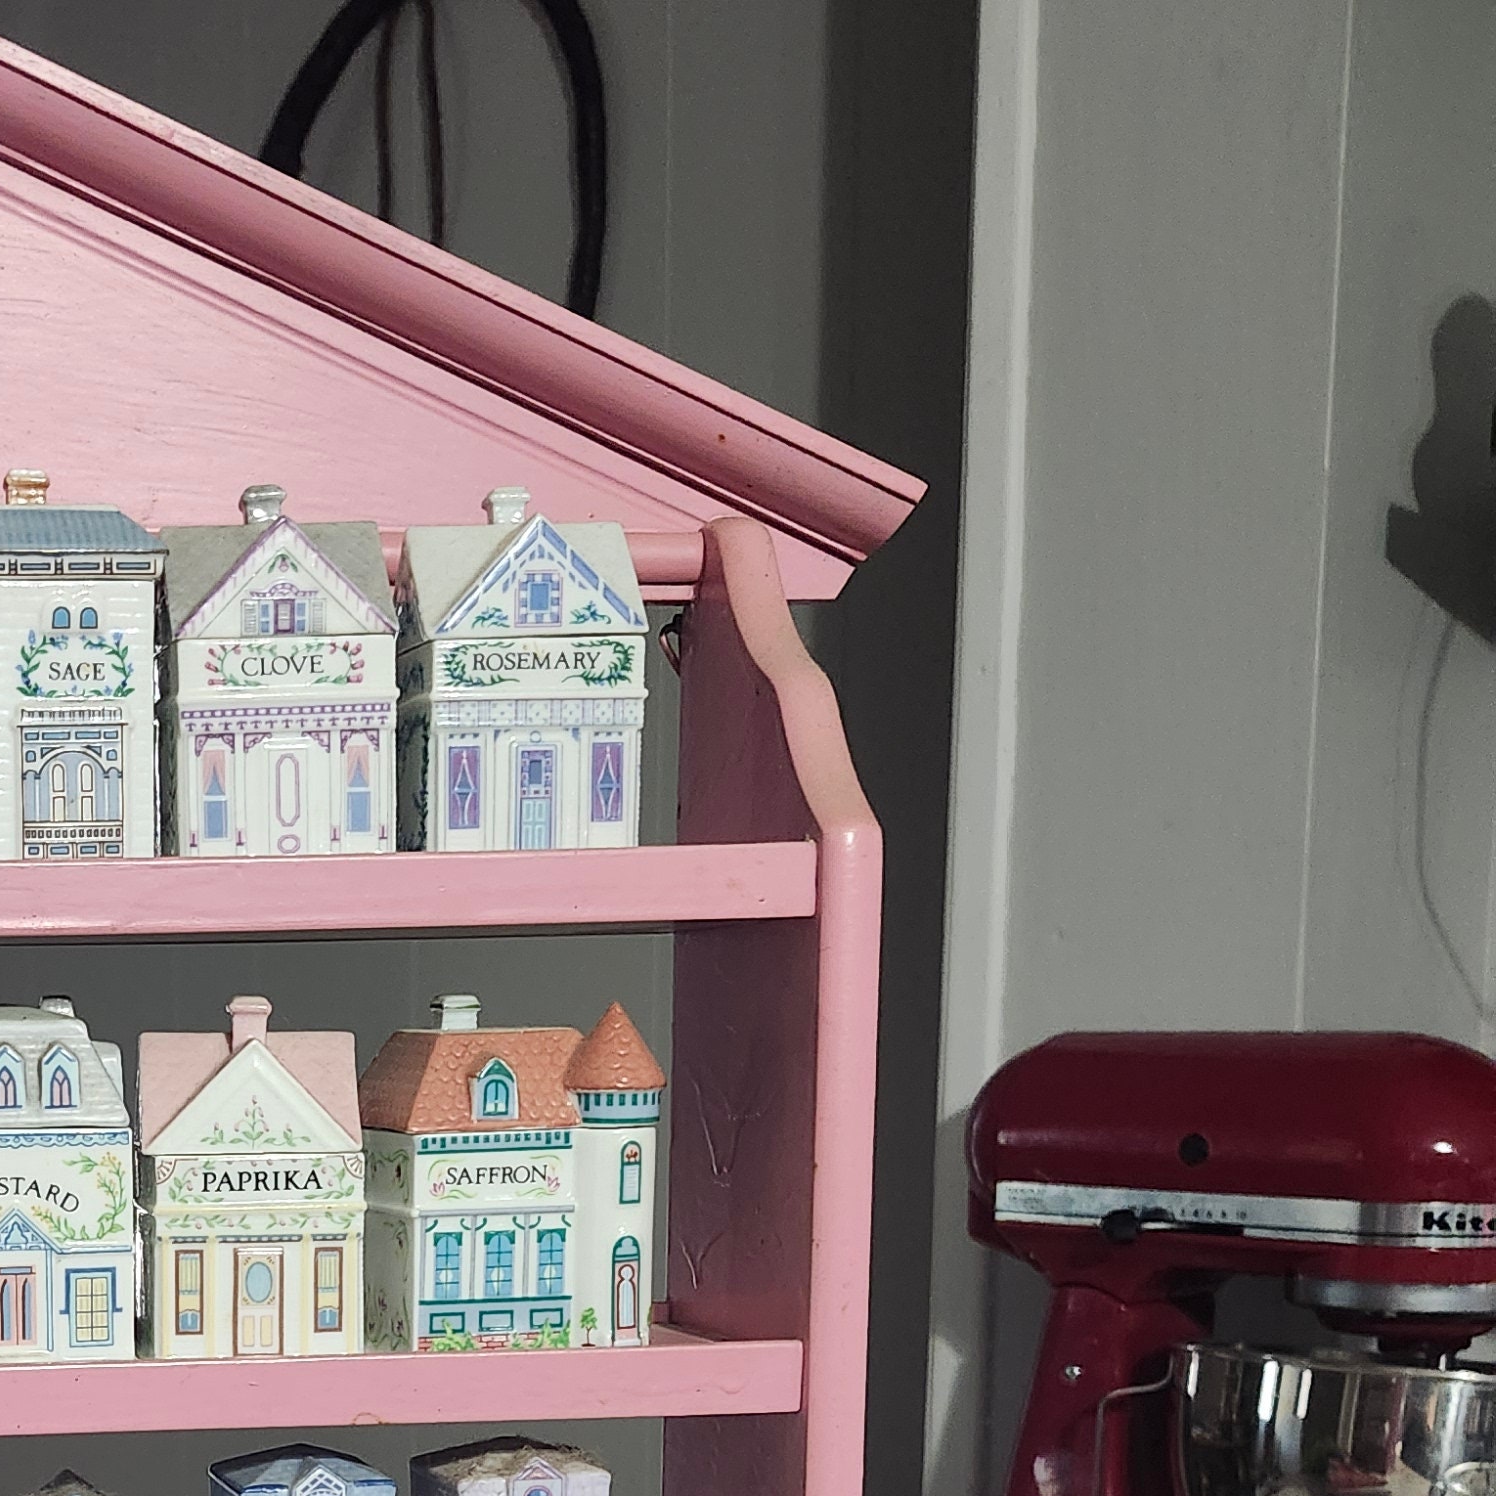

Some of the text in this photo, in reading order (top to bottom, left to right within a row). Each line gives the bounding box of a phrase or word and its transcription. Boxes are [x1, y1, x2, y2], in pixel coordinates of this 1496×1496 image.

[48, 661, 106, 681] SAGE
[240, 654, 325, 677] CLOVE
[472, 651, 602, 672] ROSEMARY
[200, 1168, 324, 1193] PAPRIKA
[445, 1164, 548, 1186] SAFFRON
